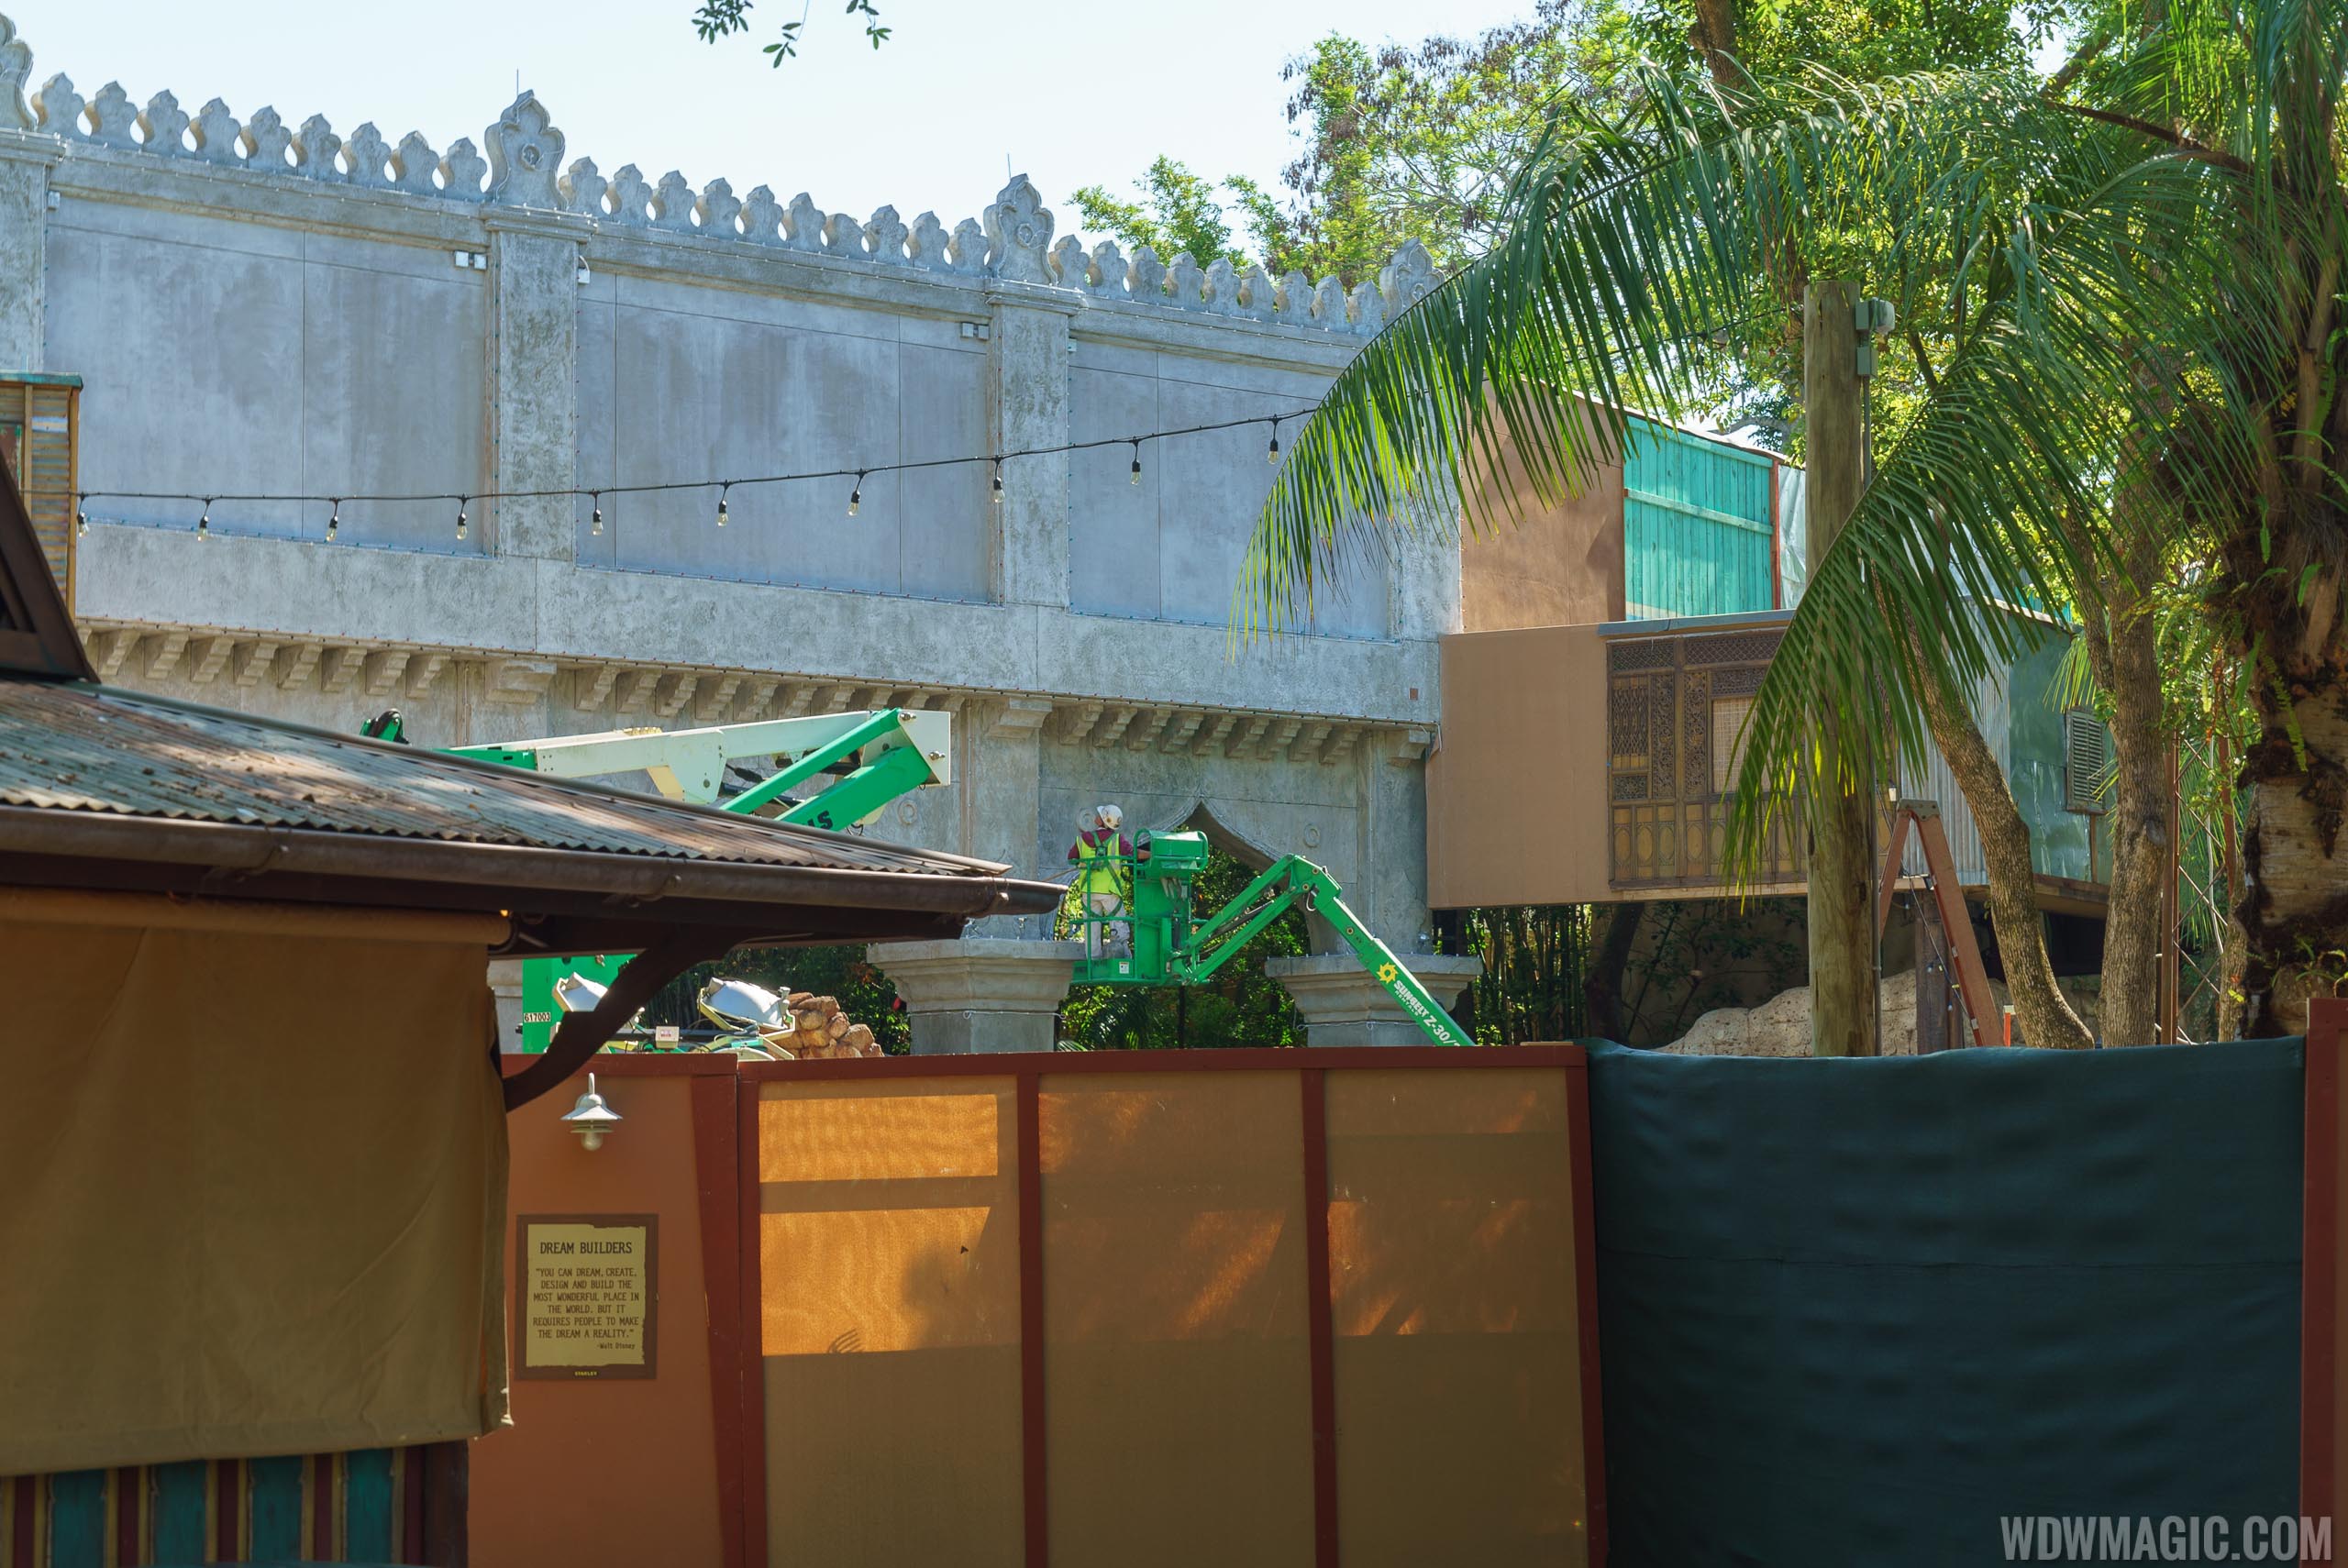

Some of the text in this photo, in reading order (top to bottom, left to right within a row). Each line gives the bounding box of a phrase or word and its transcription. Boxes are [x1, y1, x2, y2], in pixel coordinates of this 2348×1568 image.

[1394, 980, 1429, 1017] SUNBELT
[525, 1012, 549, 1021] 617003
[540, 1242, 632, 1253] DREAM BUILDERS
[559, 1268, 572, 1276] CAN
[541, 1280, 632, 1289] DESIGN AND BUILD THE
[534, 1292, 639, 1302] MOST WONDERFUL PLACE IN
[548, 1305, 562, 1314] THE
[597, 1305, 612, 1313] BUT
[616, 1305, 626, 1313] IT
[533, 1317, 638, 1327] REQUIRES PEOPLE TO MAKE
[537, 1330, 552, 1339] THE
[556, 1330, 581, 1338] DREAM
[584, 1330, 589, 1338] A
